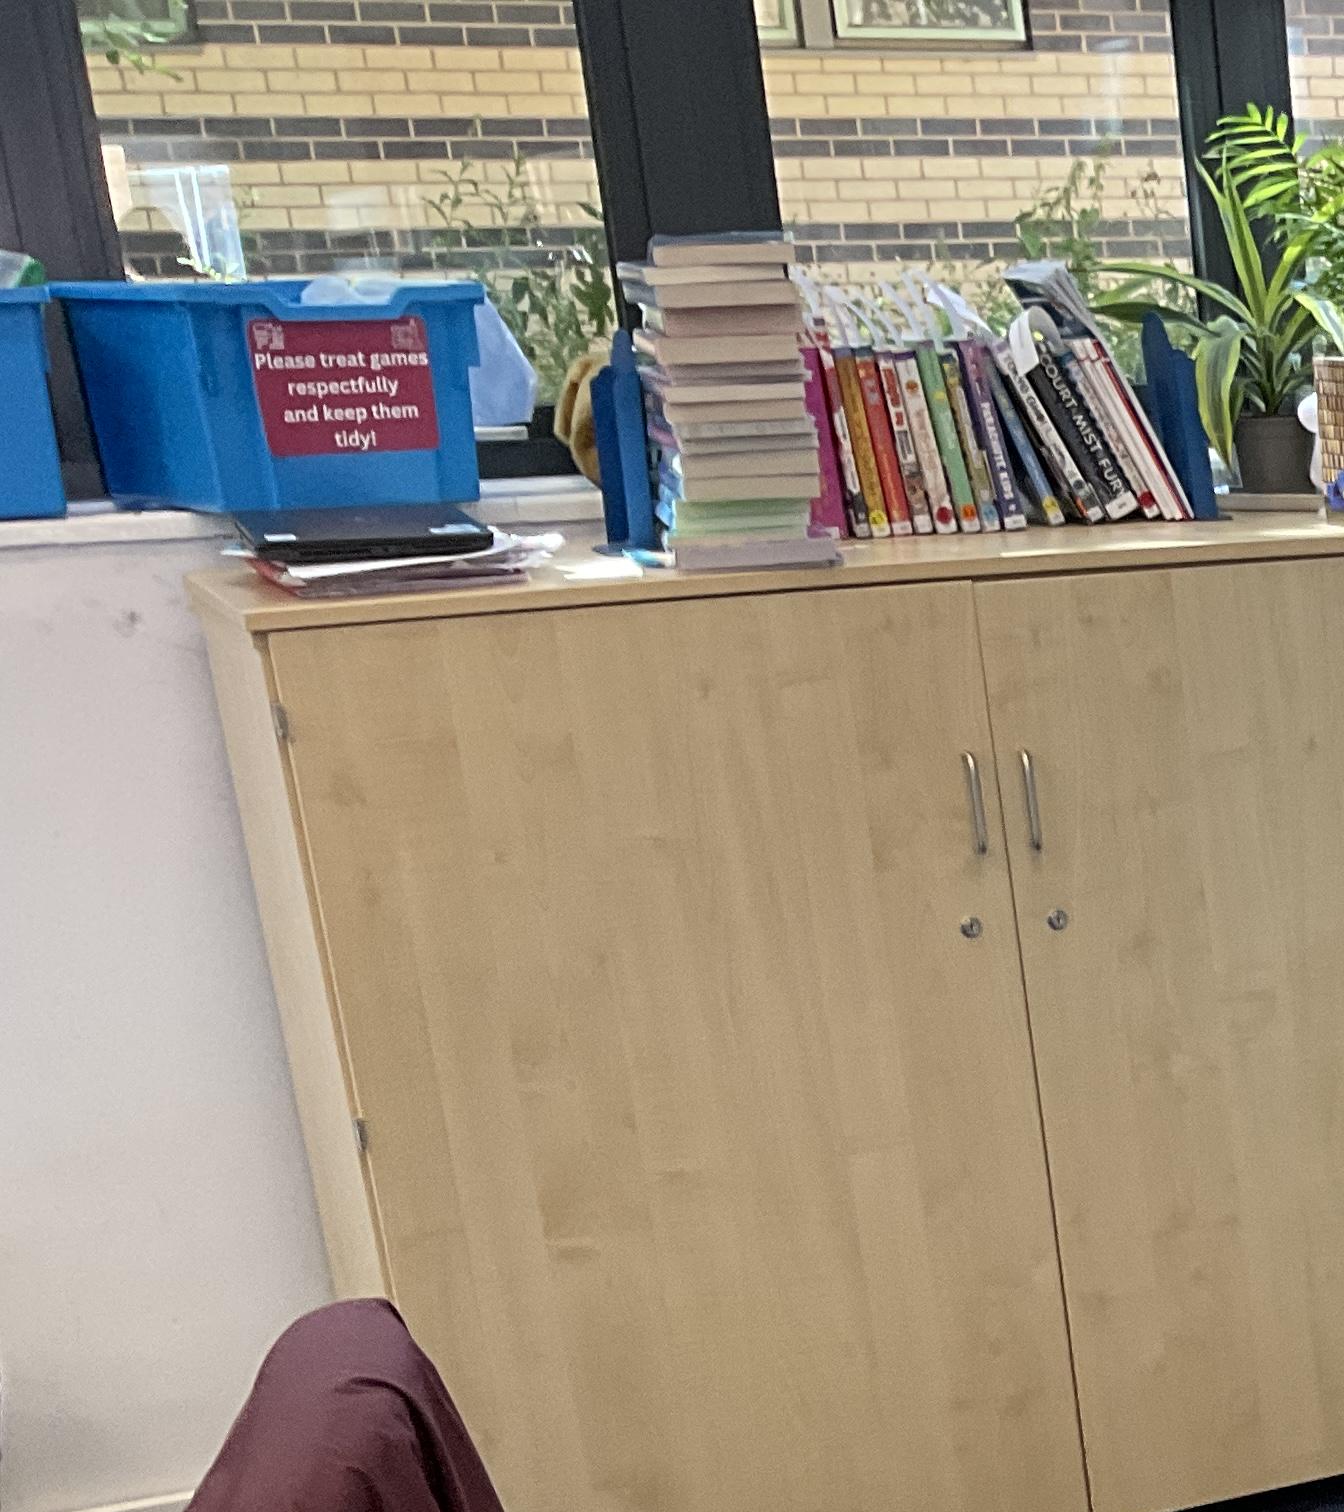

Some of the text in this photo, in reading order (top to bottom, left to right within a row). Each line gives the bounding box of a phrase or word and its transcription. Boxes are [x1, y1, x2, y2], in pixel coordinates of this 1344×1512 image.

[255, 351, 428, 370] Please treat games
[288, 375, 399, 399] respectfully
[284, 402, 419, 424] and keep them
